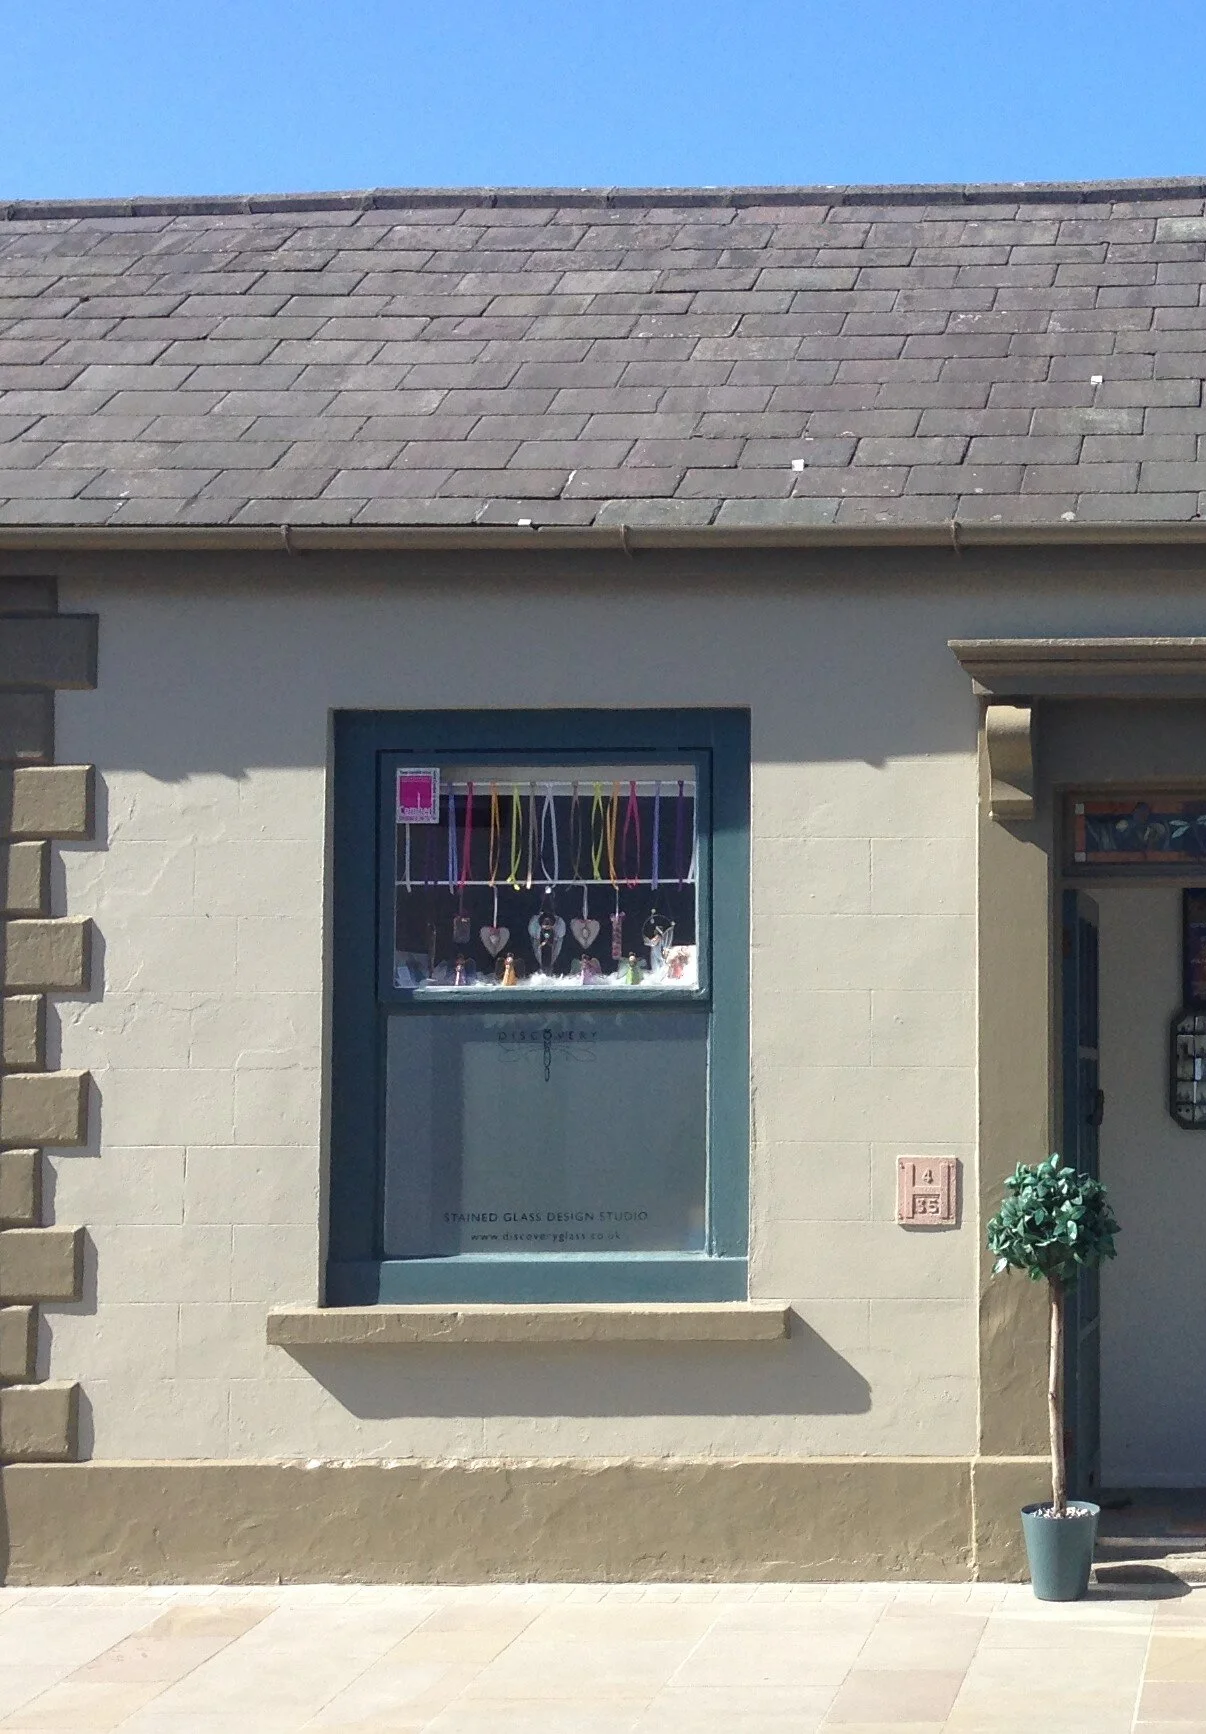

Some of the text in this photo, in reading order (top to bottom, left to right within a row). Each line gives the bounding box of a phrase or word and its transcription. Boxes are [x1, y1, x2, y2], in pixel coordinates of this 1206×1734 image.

[497, 1030, 598, 1041] DISCOVERY
[922, 1168, 934, 1184] 4
[443, 1211, 648, 1223] STAINED GLASS DESIGN STUDIO
